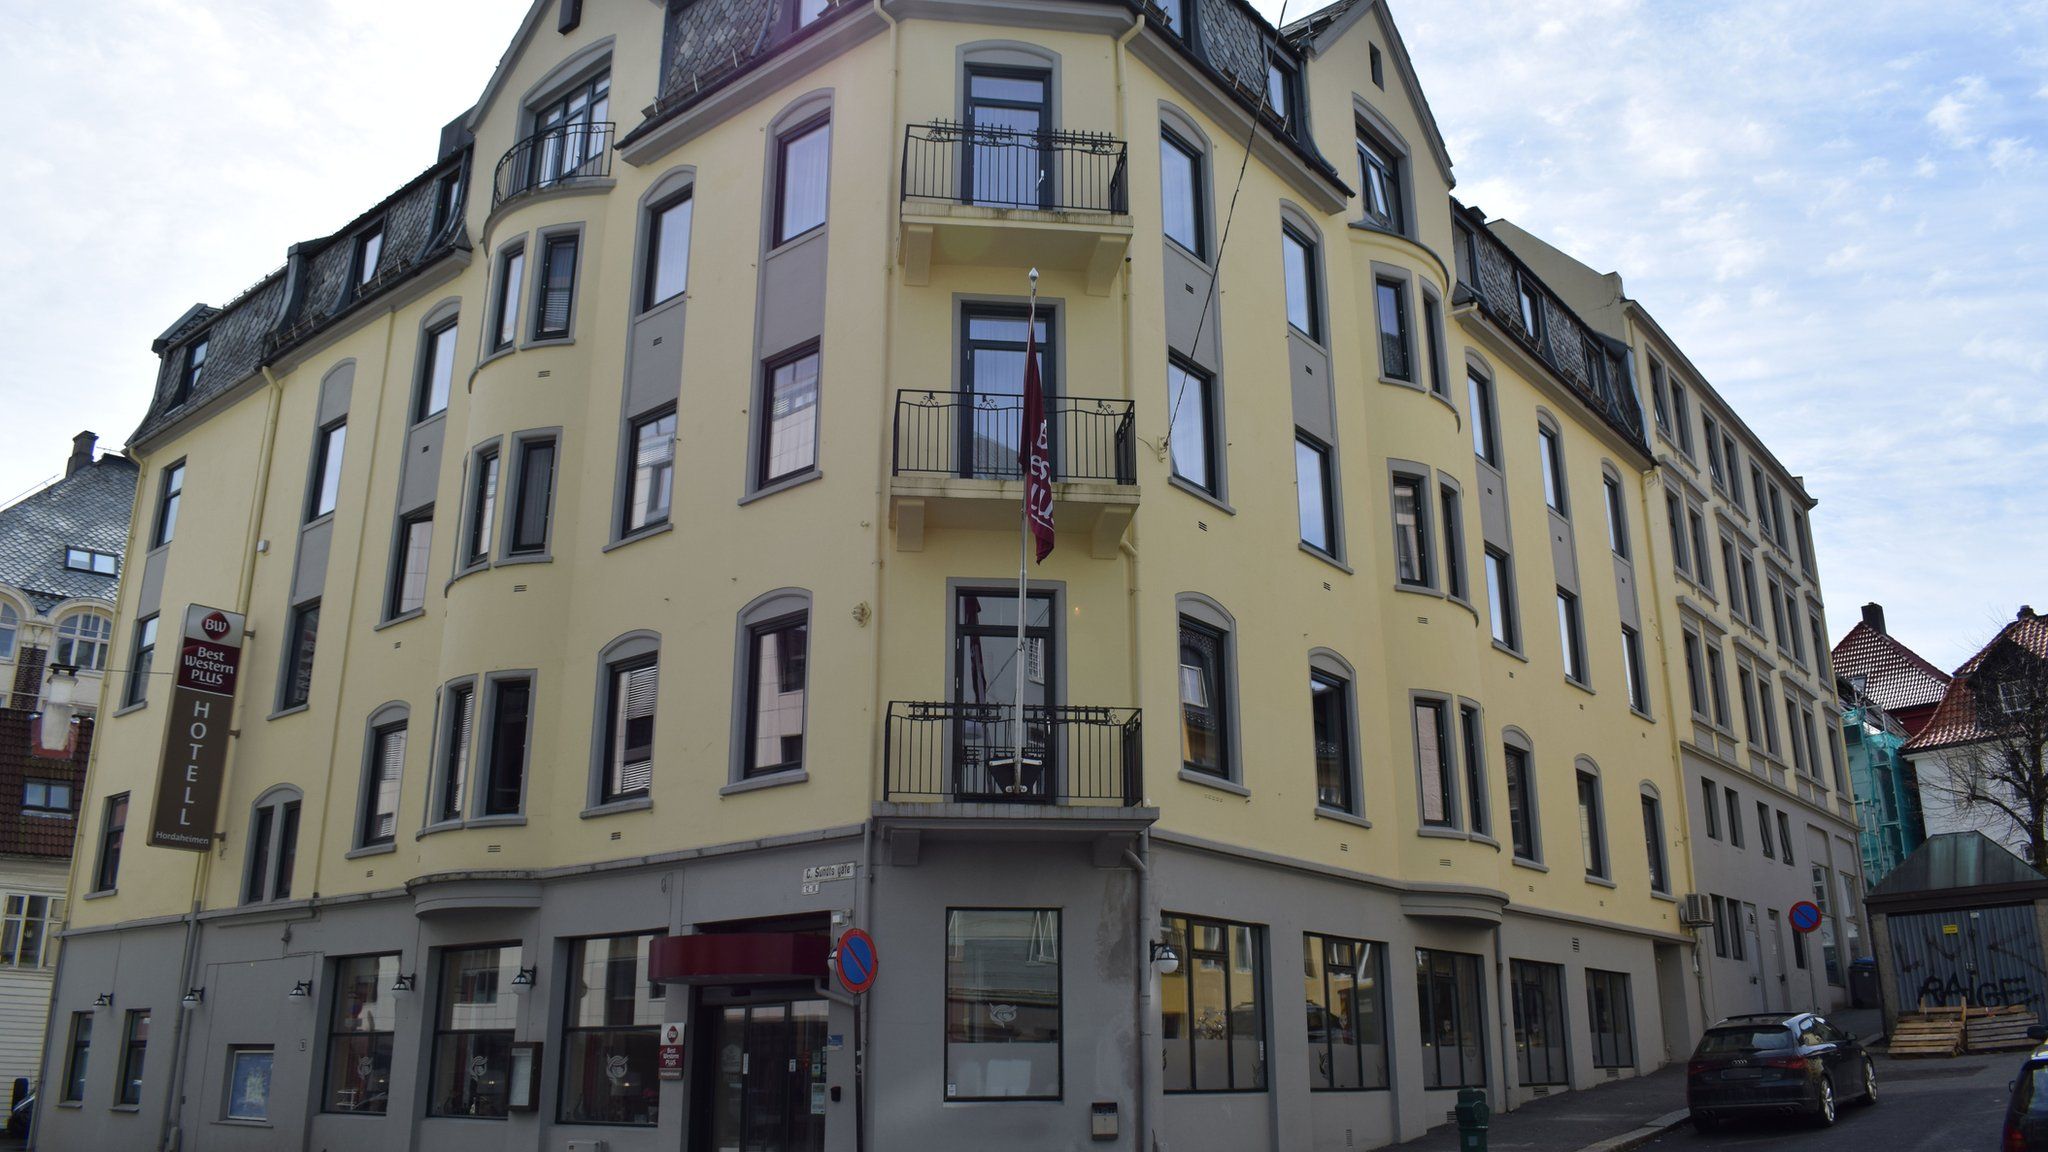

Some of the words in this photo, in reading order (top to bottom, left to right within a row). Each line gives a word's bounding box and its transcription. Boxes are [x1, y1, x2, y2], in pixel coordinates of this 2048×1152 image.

[205, 618, 227, 634] BW
[197, 646, 225, 662] Best
[185, 654, 234, 675] Western
[191, 670, 223, 685] PLUS
[179, 700, 210, 826] HOTELL
[156, 830, 209, 844] Hordaheimen
[806, 868, 813, 879] C.
[838, 864, 851, 877] gate
